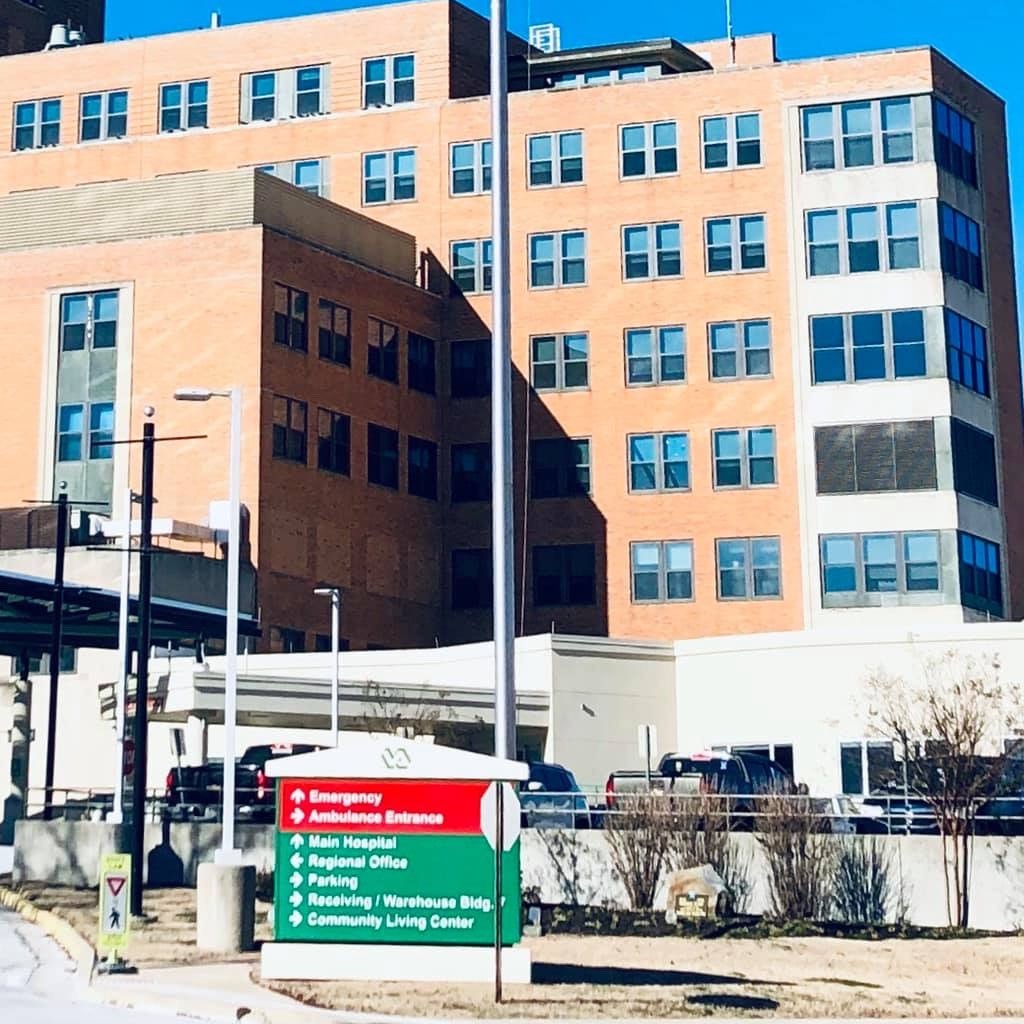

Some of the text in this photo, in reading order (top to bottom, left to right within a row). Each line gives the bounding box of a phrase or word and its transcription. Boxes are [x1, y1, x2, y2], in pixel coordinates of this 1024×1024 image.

[309, 789, 382, 807] Emergency
[308, 809, 444, 825] Ambulance Entrance
[308, 834, 397, 852] Main Hospital
[308, 853, 408, 871] Regional Office
[308, 872, 358, 891] Parking
[308, 892, 373, 910] Receiving
[383, 894, 456, 909] Warehouse
[460, 895, 495, 912] Bldg.
[307, 911, 474, 931] Community Living Center
